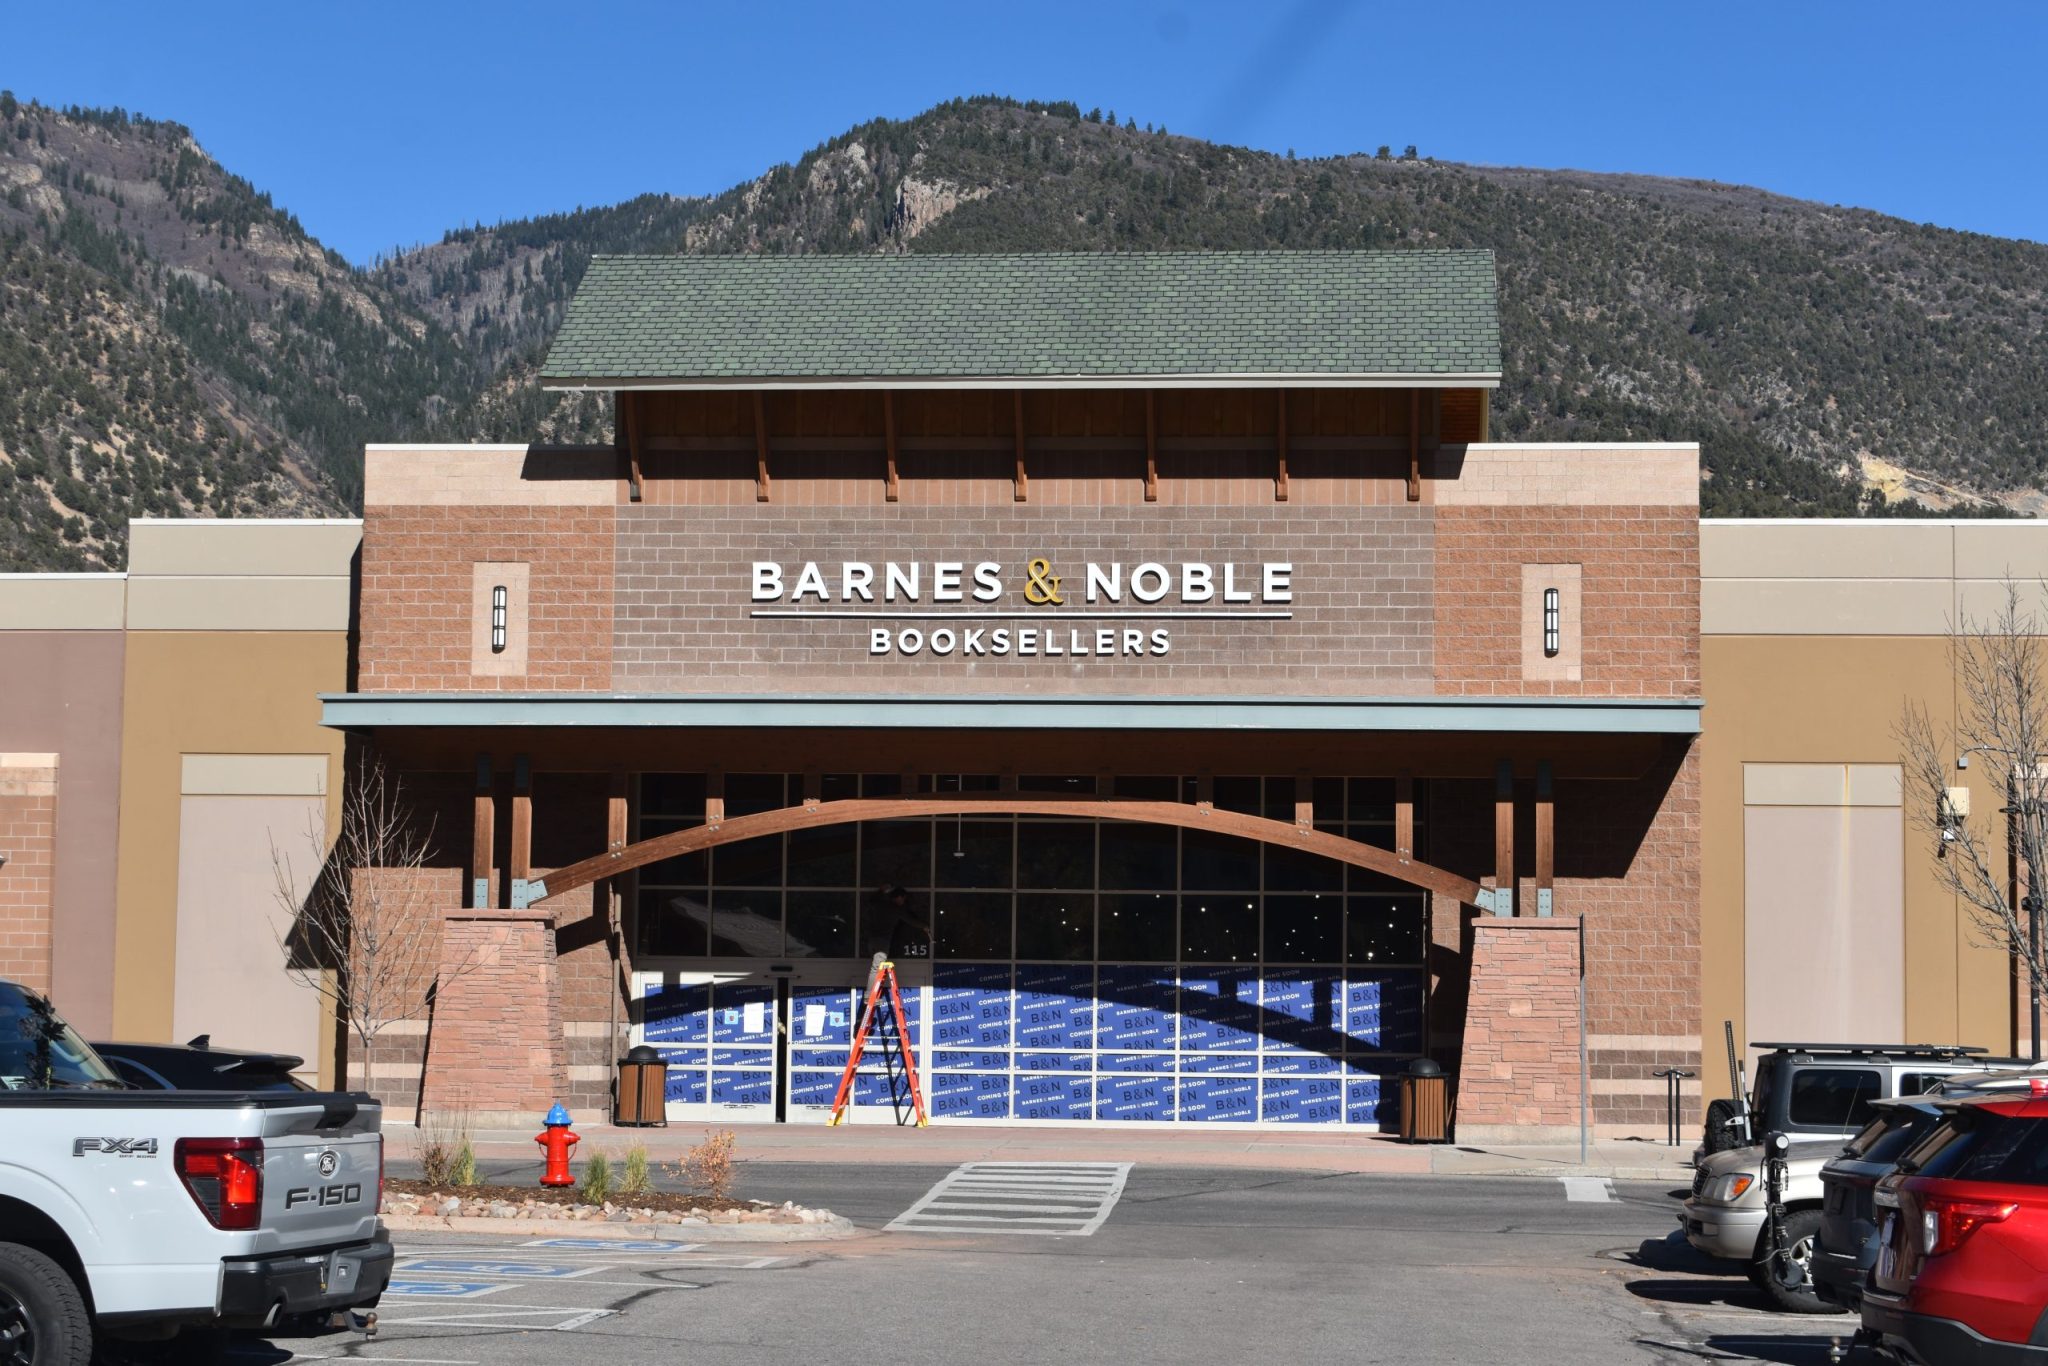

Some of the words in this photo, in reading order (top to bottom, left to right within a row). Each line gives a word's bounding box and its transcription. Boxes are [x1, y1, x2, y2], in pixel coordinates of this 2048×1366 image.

[752, 562, 1003, 600] BARNES
[1024, 558, 1064, 606] &
[1086, 562, 1292, 601] NOBLE
[870, 629, 1170, 654] BOOKSELLERS
[904, 945, 927, 956] 115
[940, 1001, 970, 1015] B&N
[978, 998, 1002, 1006] COMING
[1023, 1002, 1044, 1010] BARNES
[1348, 1004, 1373, 1012] COMING
[1031, 1010, 1062, 1024] B&N
[1116, 1008, 1137, 1016] BARNES
[978, 1021, 1002, 1029] COMING
[1124, 1016, 1155, 1029] B&N
[940, 1025, 970, 1039] B&N
[1023, 1026, 1044, 1034] BARNES
[1116, 1032, 1136, 1040] BARNES
[1348, 1028, 1372, 1036] COMING
[816, 1034, 833, 1042] SOON
[1030, 1034, 1061, 1048] B&N
[1163, 1036, 1187, 1044] COMNG
[816, 1054, 846, 1067] B&N
[1030, 1057, 1061, 1070] B&N
[1163, 1058, 1187, 1067] COMNG
[795, 1072, 824, 1084] B&N
[939, 1074, 969, 1087] B&N
[1116, 1080, 1136, 1088] BARNES
[1030, 1082, 1061, 1095] B&N
[1162, 1083, 1187, 1092] COMNG
[1188, 1080, 1206, 1088] SOON
[1309, 1081, 1340, 1095] B&N
[977, 1092, 1001, 1101] COMING
[1124, 1087, 1154, 1101] B&N
[938, 1097, 969, 1110] B&N
[1116, 1104, 1136, 1112] BARNES
[1216, 1097, 1246, 1110] B&N
[1348, 1101, 1372, 1109] COMING
[1030, 1105, 1060, 1119] B&N
[1162, 1107, 1186, 1116] COMNG
[1309, 1105, 1339, 1119] B&N
[73, 1137, 158, 1157] FX4
[286, 1184, 361, 1210] F-150
